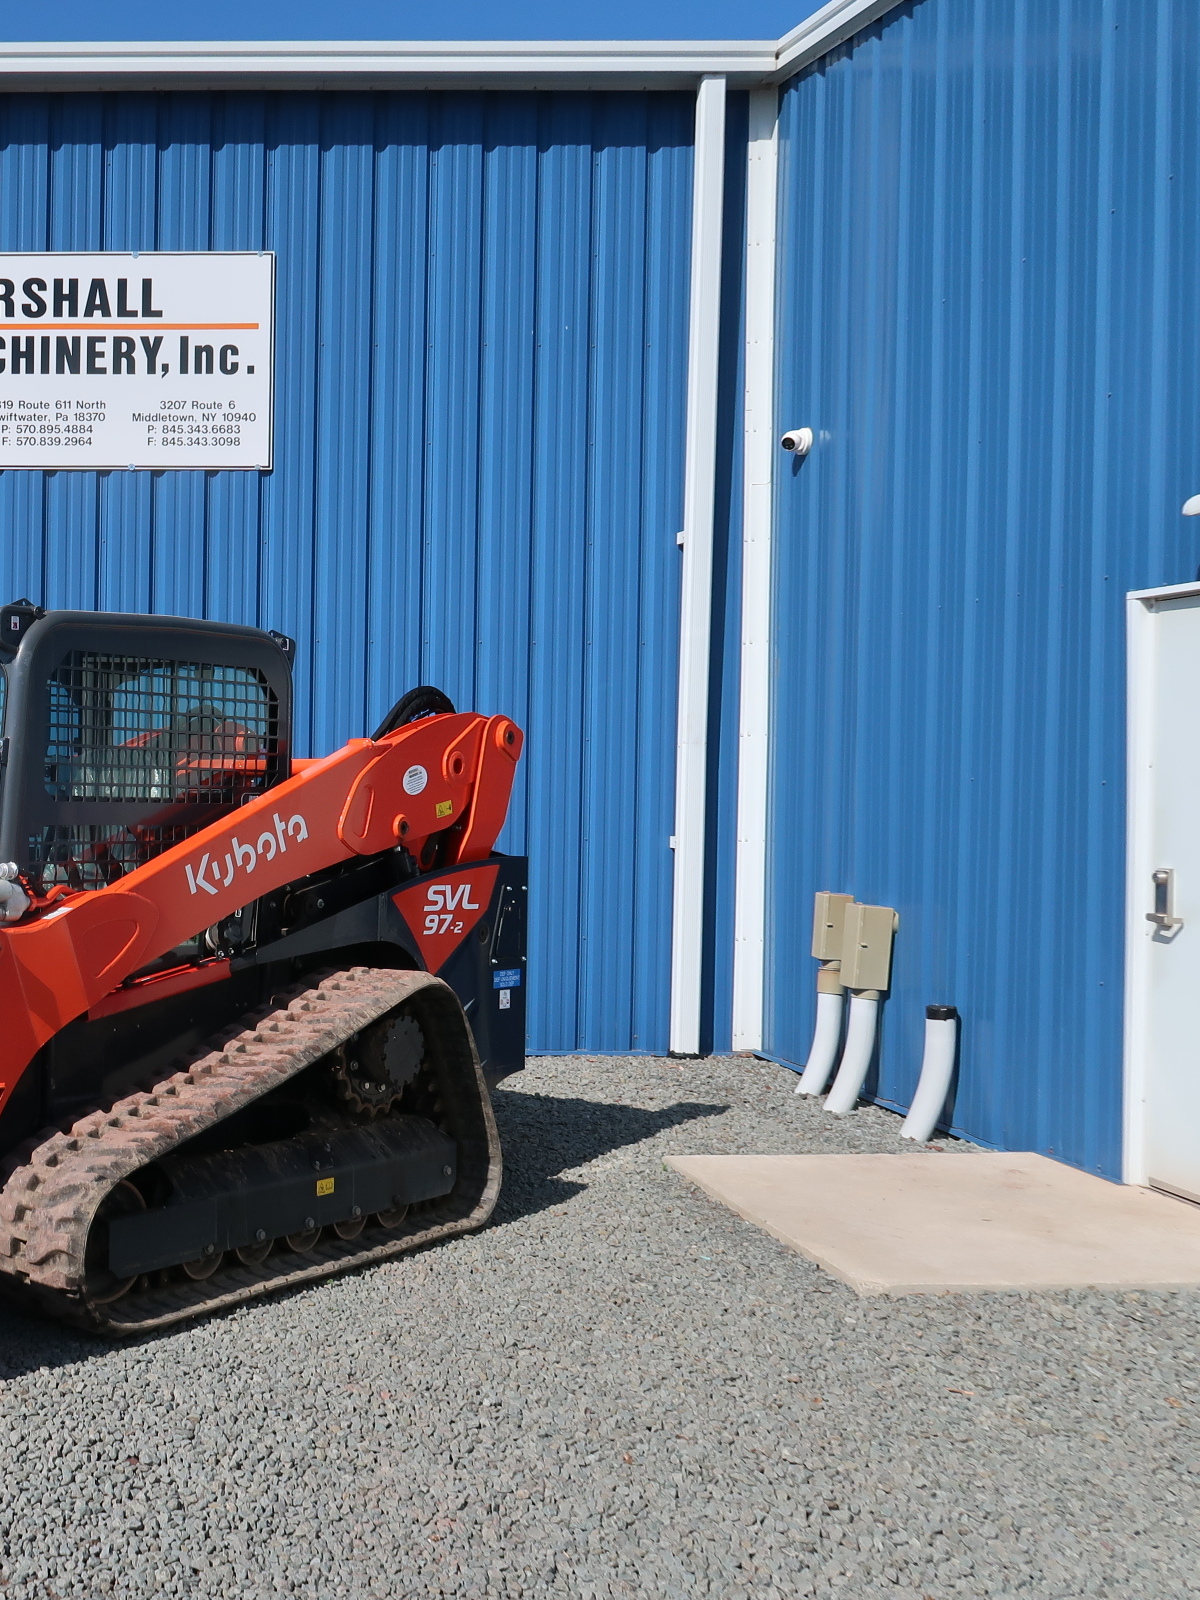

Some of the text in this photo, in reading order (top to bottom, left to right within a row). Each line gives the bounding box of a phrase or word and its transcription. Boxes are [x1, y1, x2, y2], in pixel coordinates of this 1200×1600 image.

[179, 335, 255, 375] Inc.
[18, 400, 50, 410] Route
[55, 400, 72, 410] 611
[76, 400, 106, 410] North
[160, 400, 236, 410] 3207 Route 6
[55, 412, 69, 422] Pa
[73, 412, 106, 422] 18370
[132, 412, 256, 423] Middletown, NY 10940
[1, 424, 94, 434] P: 570.895.4884
[147, 424, 241, 434] P: 845.343.6683
[1, 436, 93, 446] F: 570.839.2964
[147, 436, 241, 446] F: 845.343.3098
[184, 812, 309, 896] Kubota
[423, 884, 480, 912] SVL
[422, 914, 464, 935] 97-2
